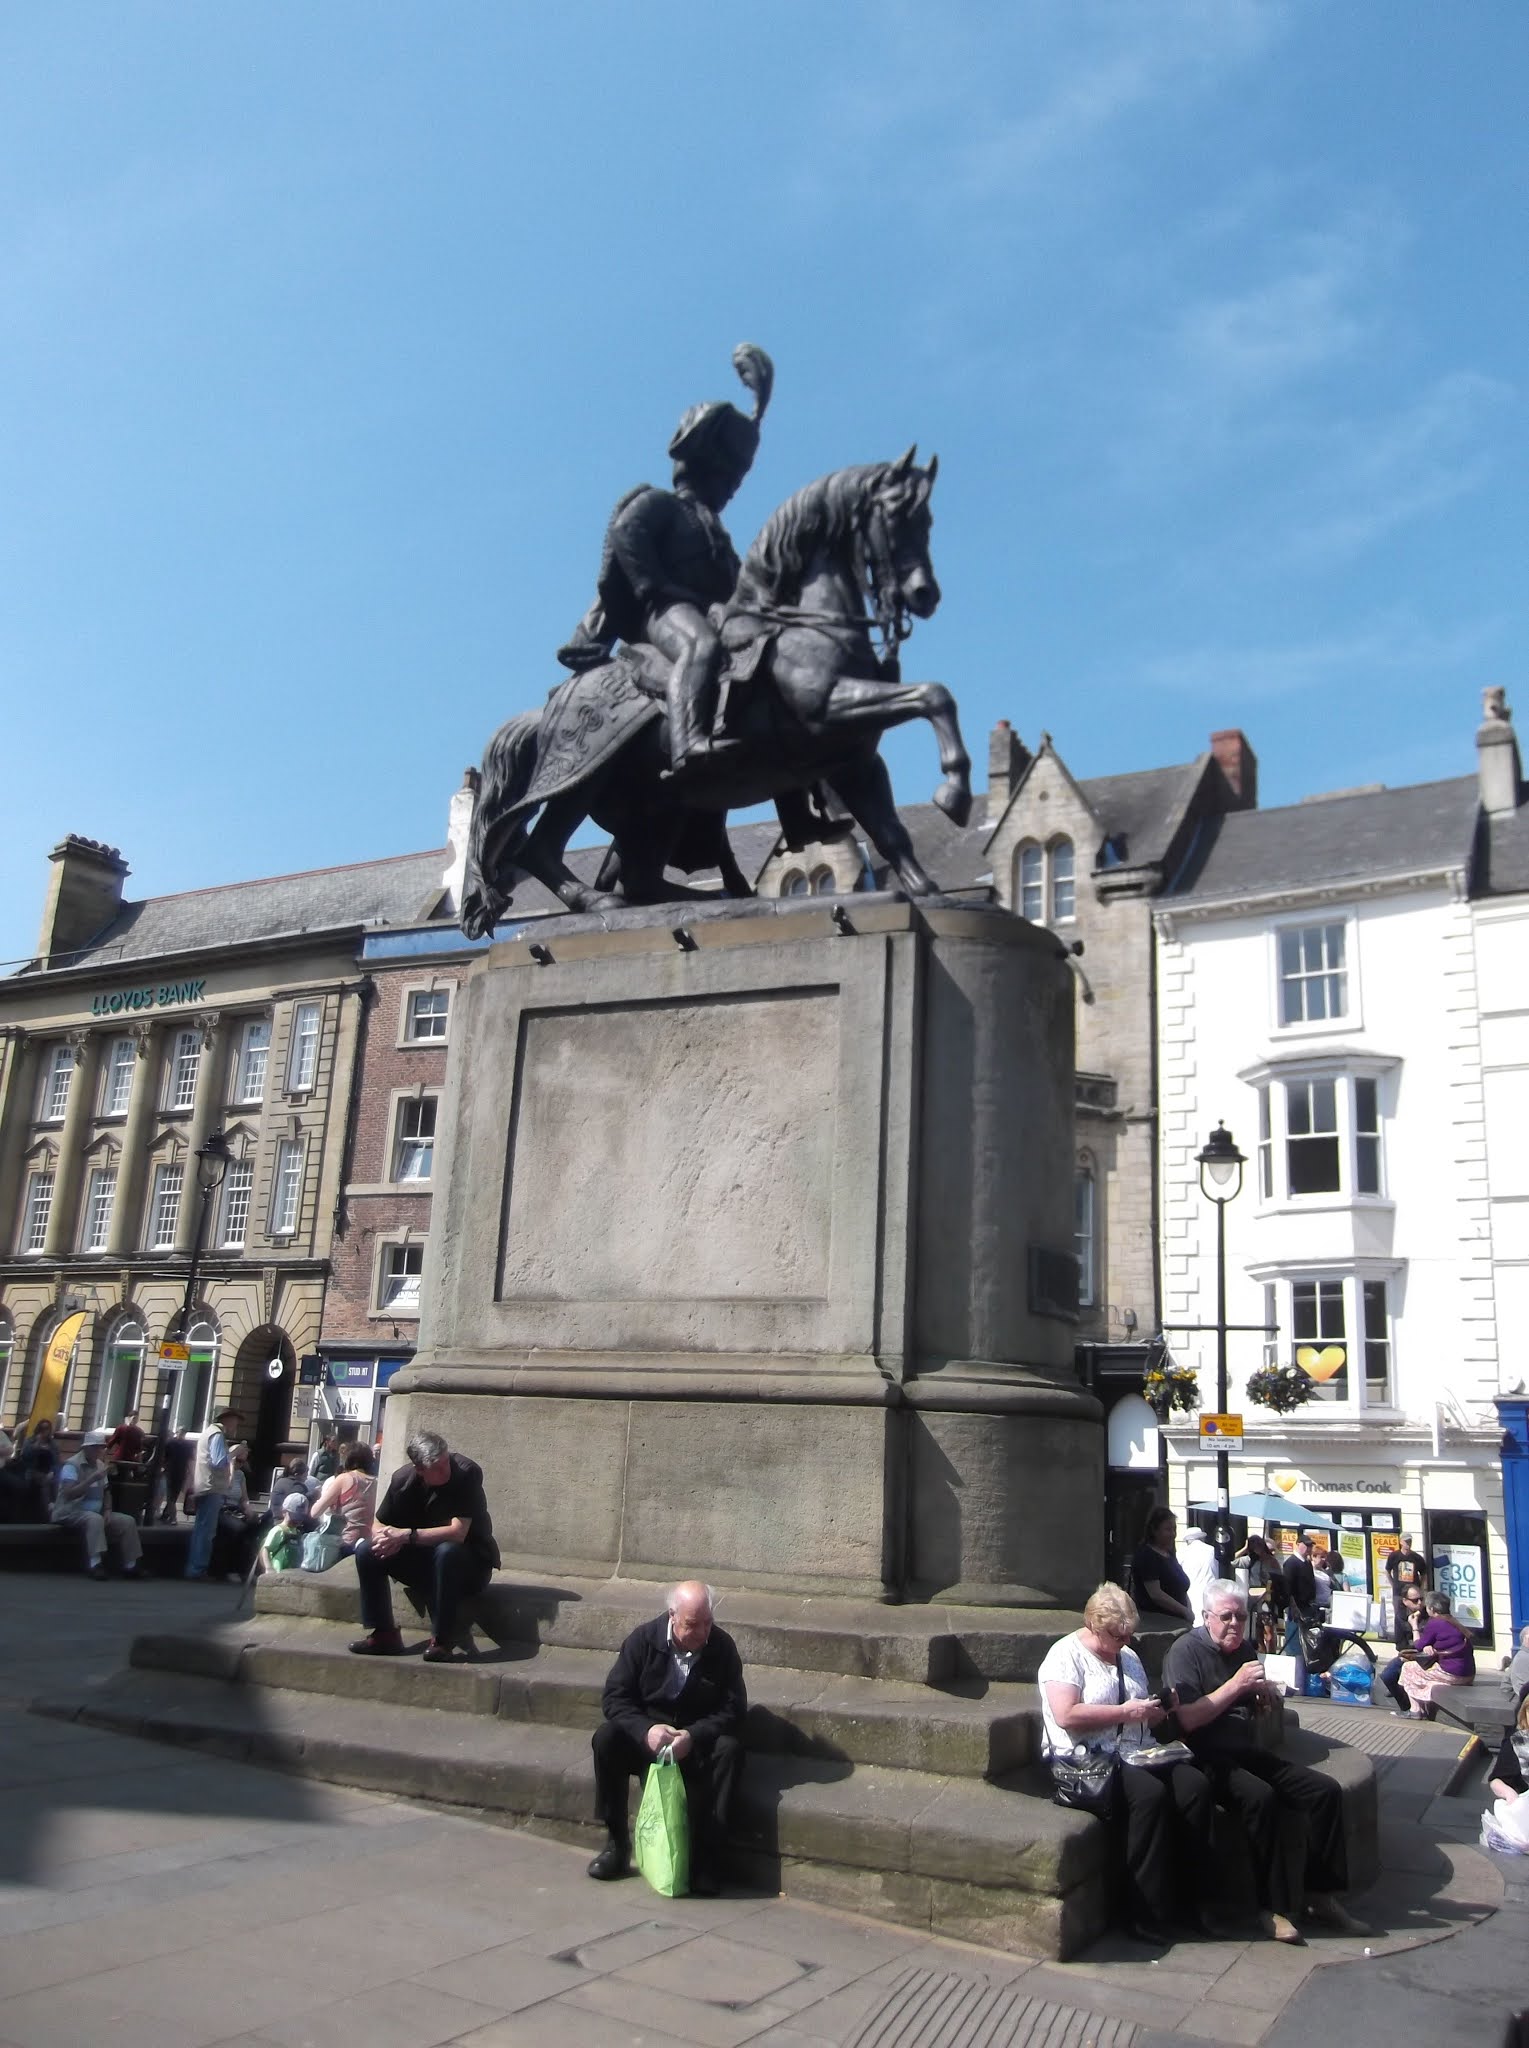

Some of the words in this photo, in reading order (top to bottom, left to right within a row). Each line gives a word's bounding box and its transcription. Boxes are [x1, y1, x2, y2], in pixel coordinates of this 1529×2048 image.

[92, 989, 153, 1015] LLOYDS
[157, 980, 206, 1006] BANK
[335, 1397, 359, 1415] Saks
[1300, 1480, 1353, 1493] Thomas
[1356, 1480, 1392, 1493] Cook
[1373, 1538, 1398, 1546] DEALS
[1440, 1563, 1476, 1582] €30
[1440, 1582, 1477, 1599] FREE
